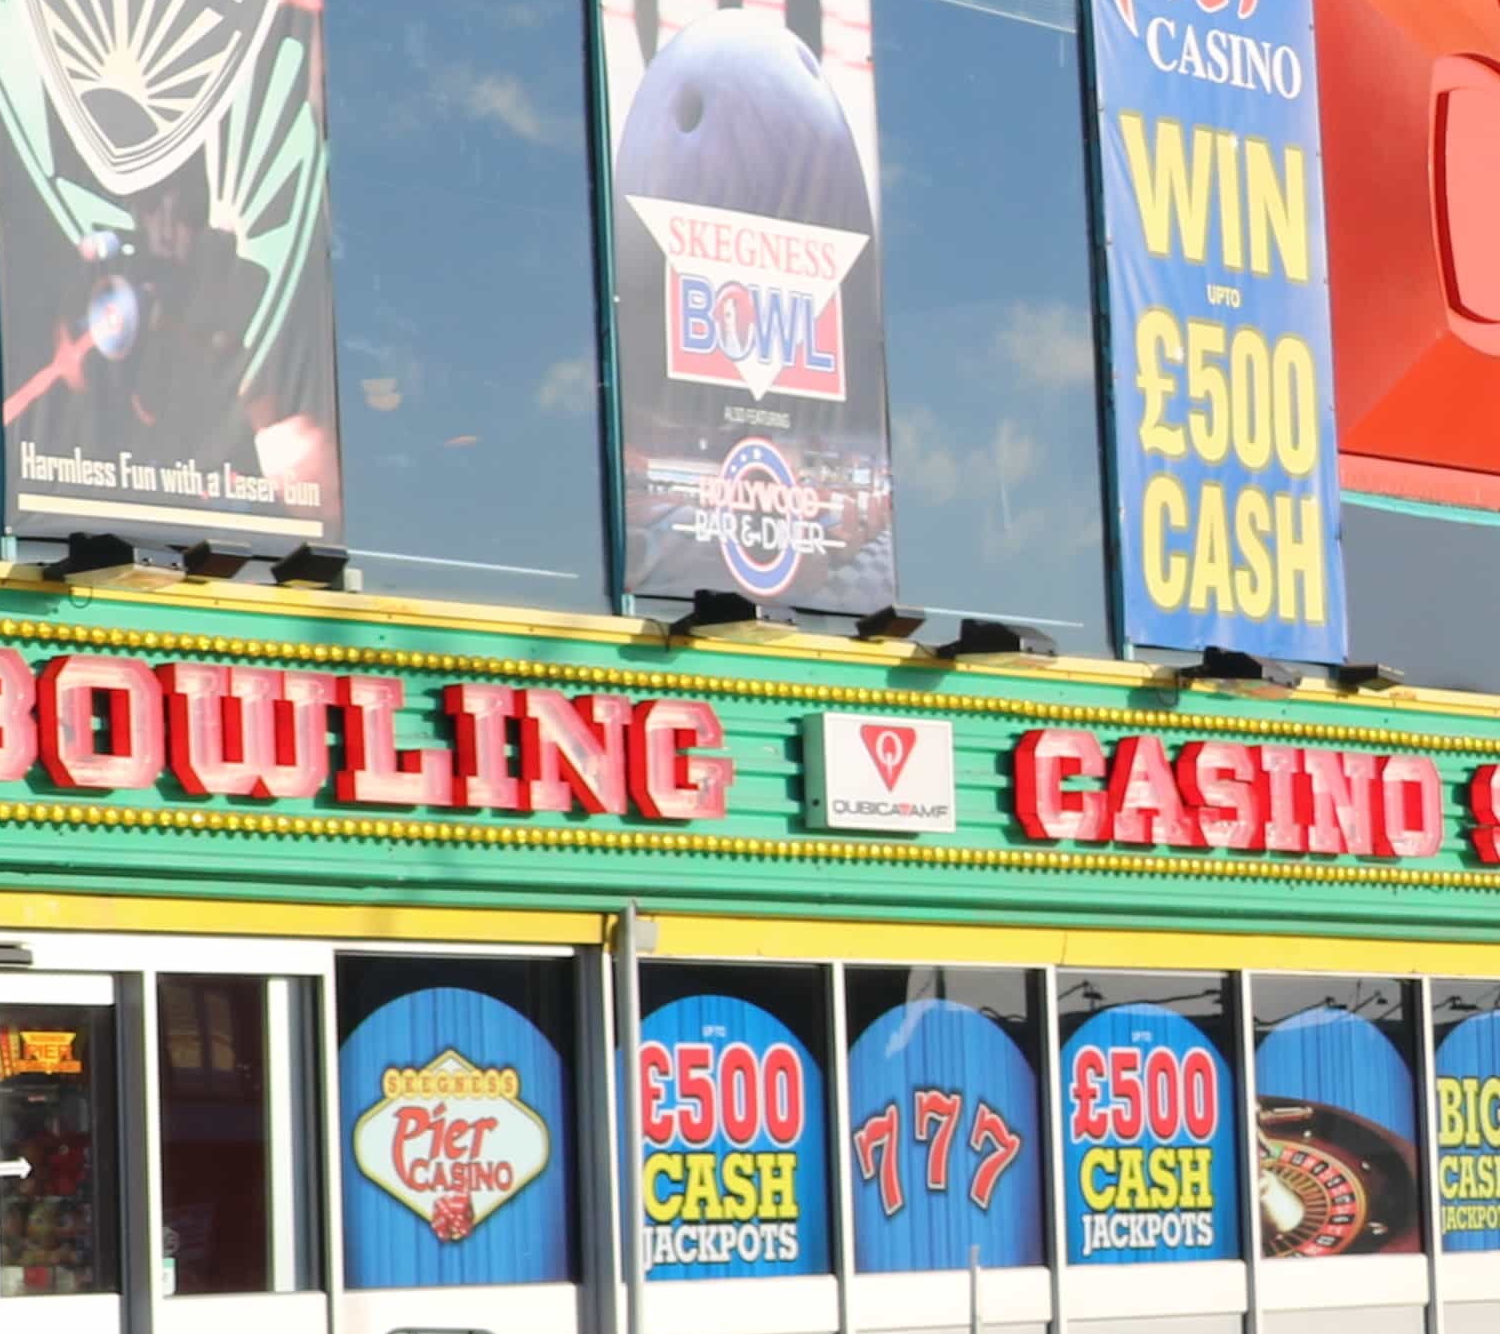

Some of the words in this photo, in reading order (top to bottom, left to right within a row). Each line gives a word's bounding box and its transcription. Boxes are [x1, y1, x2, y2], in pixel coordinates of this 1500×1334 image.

[1145, 14, 1301, 100] CASINO
[1119, 111, 1309, 285] WIN
[669, 216, 837, 281] SKEGNESS
[679, 272, 835, 372] BOWL
[1134, 307, 1320, 478] £500
[20, 440, 116, 488] Harmless
[120, 452, 157, 491] Fun
[162, 459, 203, 494] with
[207, 473, 220, 497] a
[224, 464, 278, 503] Laser
[700, 476, 818, 516] HOLLYWOOD
[695, 512, 739, 543] BAR
[762, 521, 826, 554] DINER
[1141, 474, 1325, 625] CASH
[1013, 729, 1443, 858] CASINO
[23, 1044, 72, 1059] PIER
[639, 1041, 804, 1148] £500
[1070, 1045, 1218, 1145] £500
[392, 1102, 498, 1181] Pier
[411, 1160, 513, 1192] CASINO
[643, 1153, 798, 1221] CASH
[1080, 1146, 1213, 1210] CASH
[641, 1224, 798, 1267] JACKPOTS
[1083, 1211, 1213, 1256] JACKPOTS
